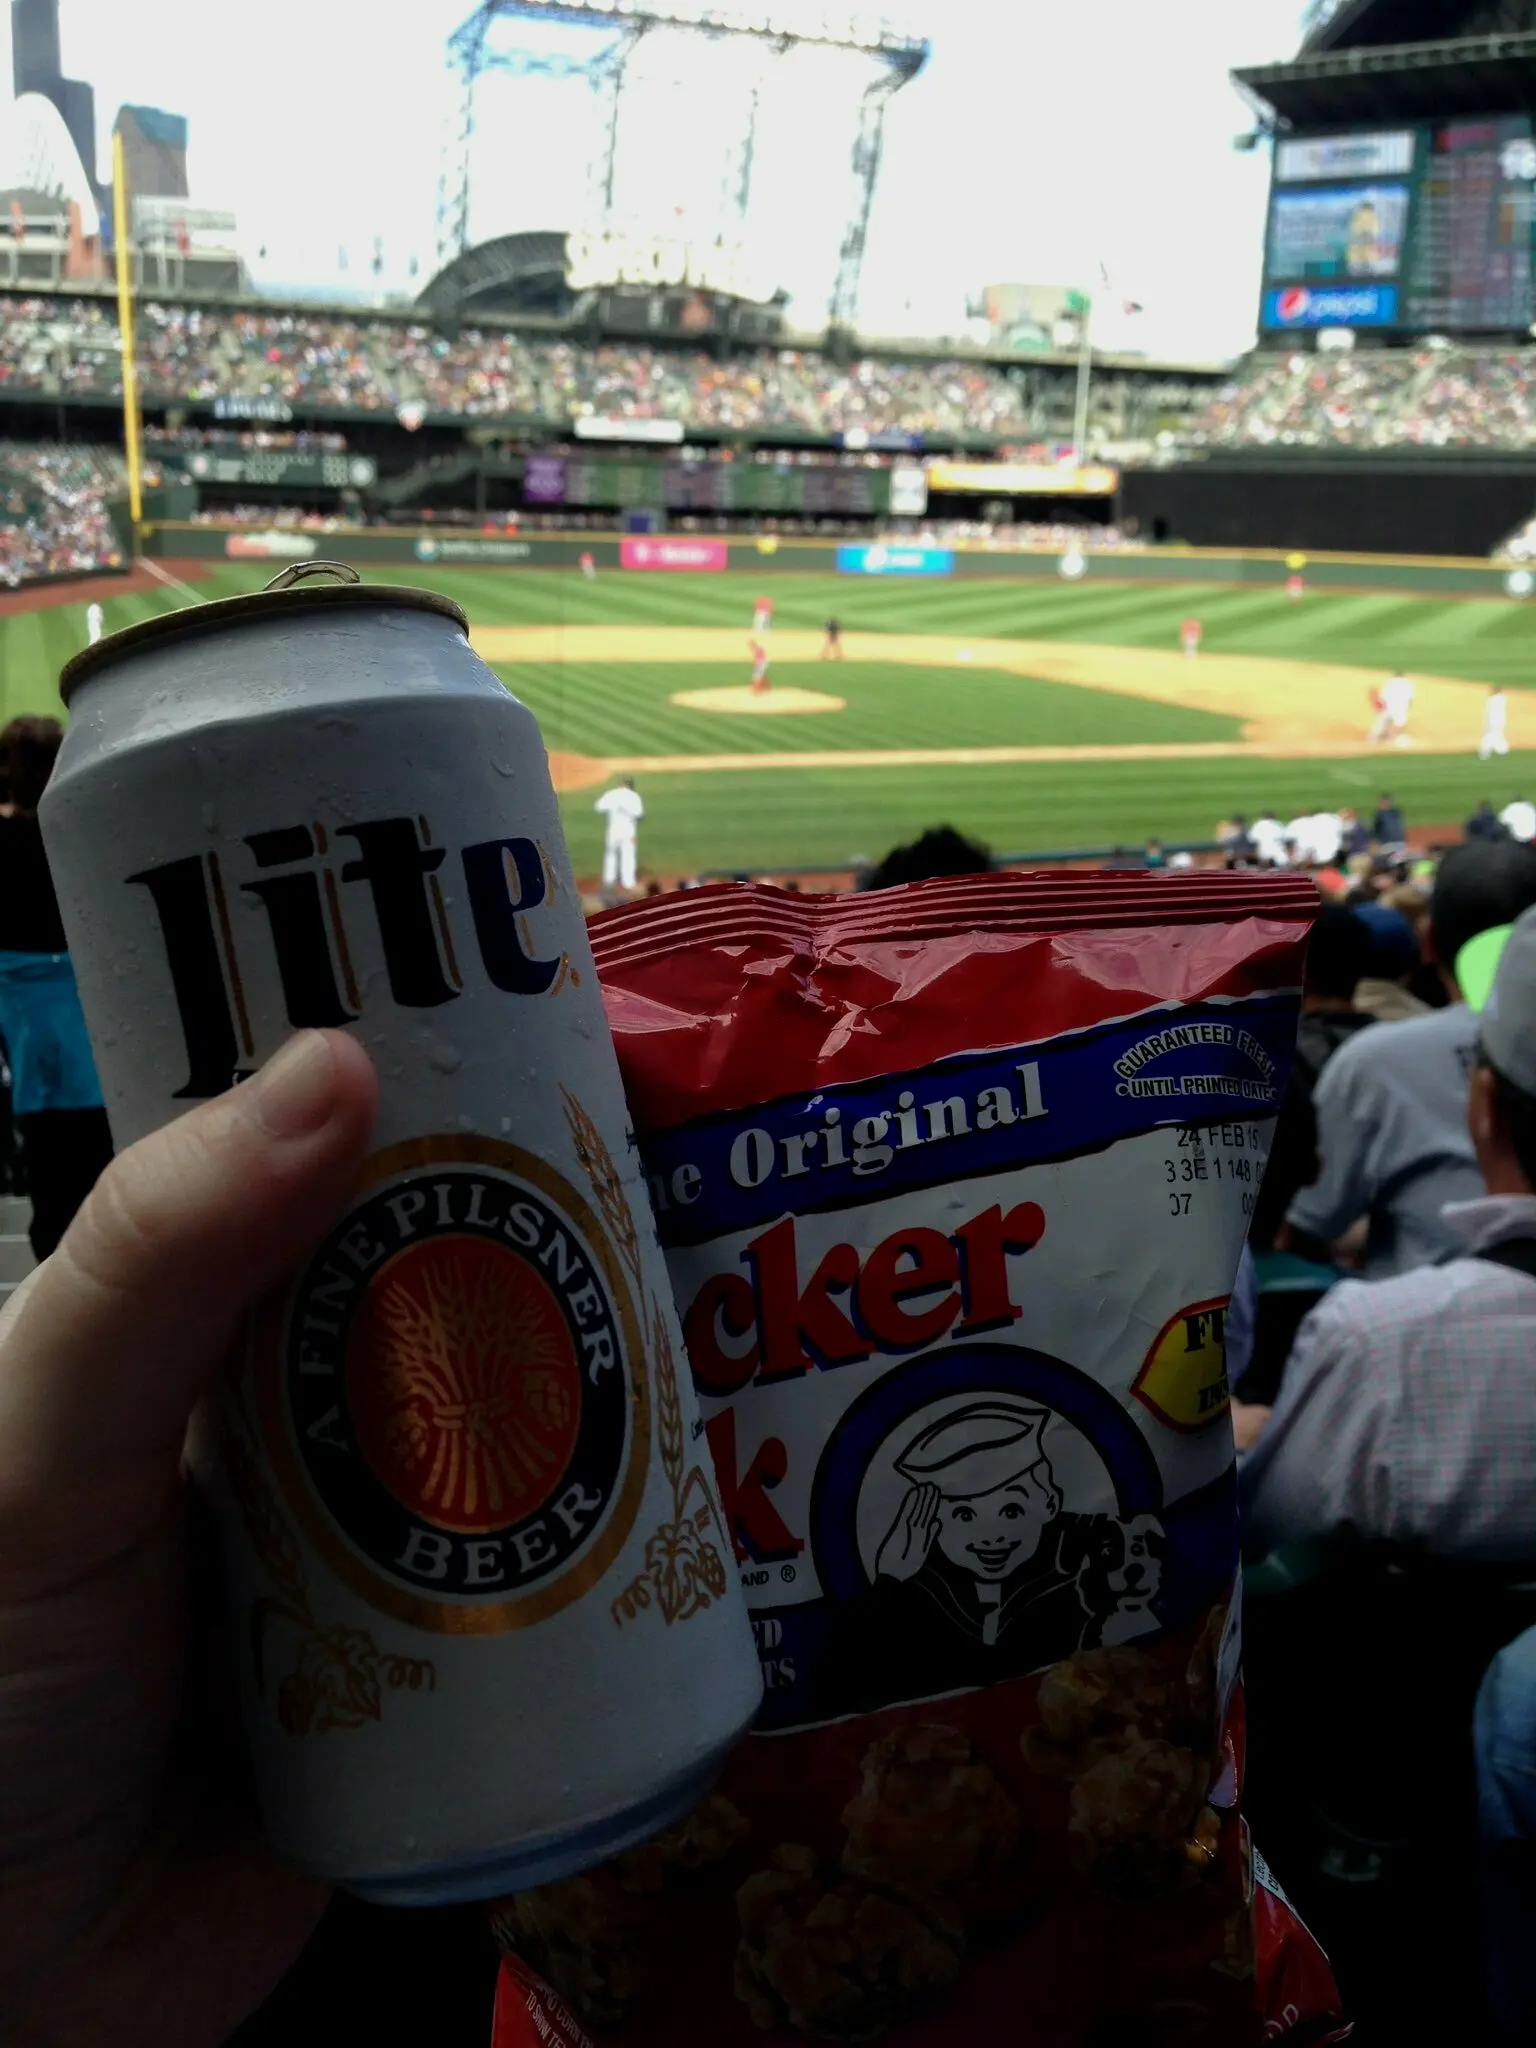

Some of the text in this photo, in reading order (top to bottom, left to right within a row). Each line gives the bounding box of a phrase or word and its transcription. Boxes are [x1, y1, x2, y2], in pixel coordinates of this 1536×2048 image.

[125, 817, 575, 1098] lite
[1114, 1024, 1234, 1079] GUARANTEED
[1130, 1078, 1180, 1097] UNTIL
[1182, 1076, 1240, 1096] PRINTED
[729, 1061, 1049, 1188] Original
[1208, 1123, 1245, 1147] FEB
[298, 1181, 617, 1454] A FINE PILSNER
[392, 1480, 603, 1588] BEER
